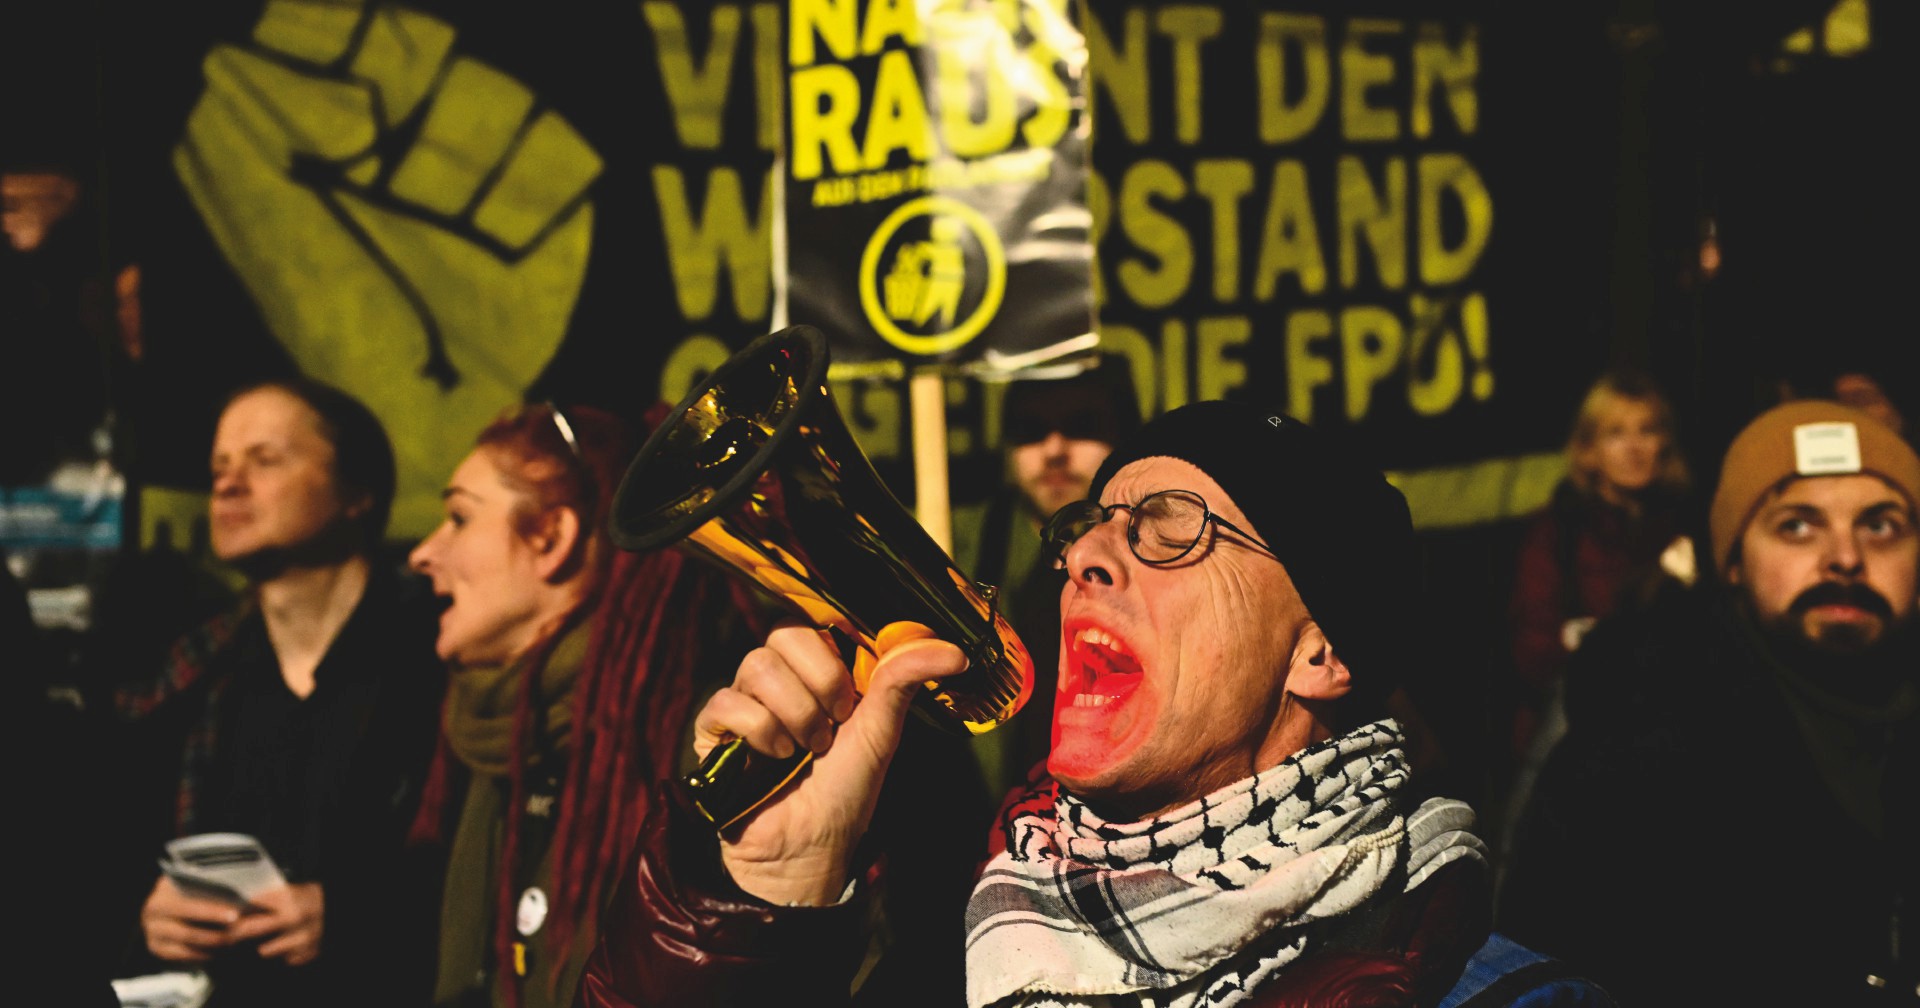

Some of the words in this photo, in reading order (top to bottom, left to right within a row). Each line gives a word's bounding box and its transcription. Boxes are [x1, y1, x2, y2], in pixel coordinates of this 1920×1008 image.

[791, 35, 1072, 180] RAUS
[1257, 13, 1479, 144] DEN
[652, 154, 1493, 320] WSTAND
[1287, 292, 1493, 424] FPÖ!
